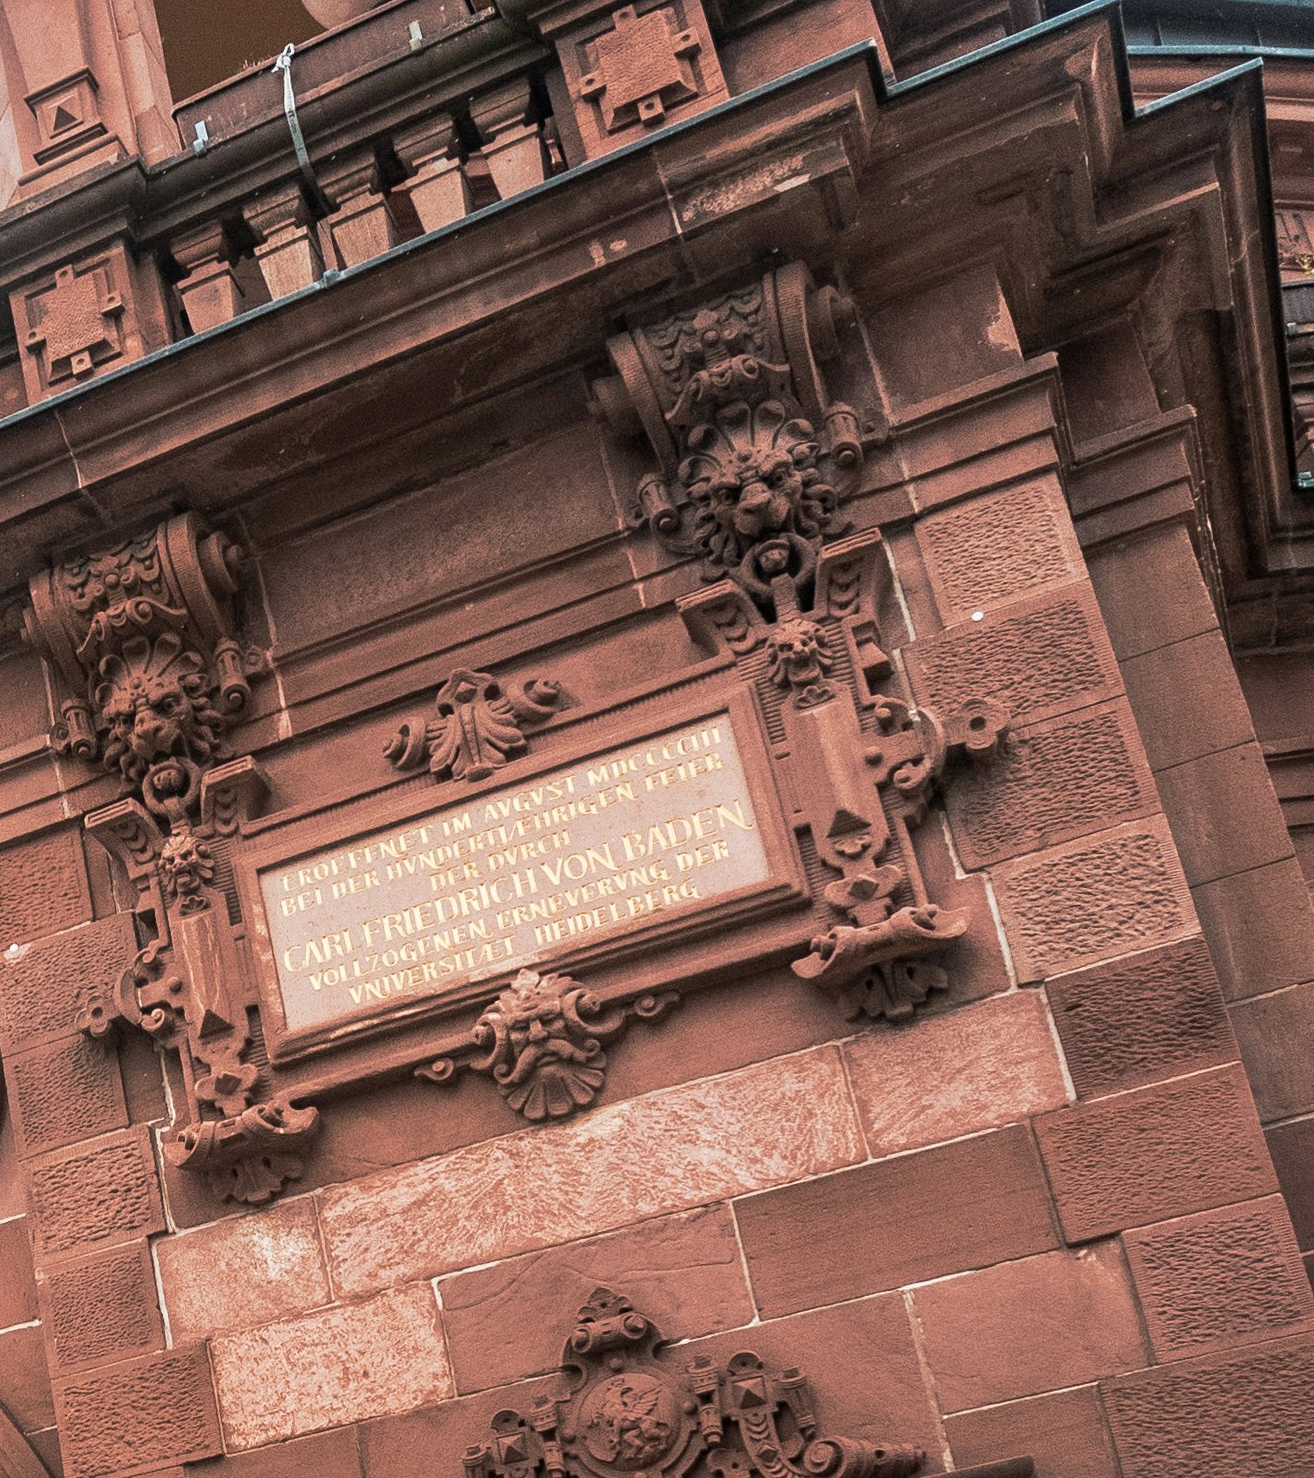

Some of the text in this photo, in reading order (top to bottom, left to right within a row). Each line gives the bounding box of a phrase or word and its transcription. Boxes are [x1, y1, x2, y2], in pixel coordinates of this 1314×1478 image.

[281, 887, 323, 917] BEI
[332, 870, 381, 899] DER
[645, 752, 723, 791] FEIER
[282, 726, 722, 892] EROEFFNET IM AVGVST MDCCCCIII
[284, 798, 754, 971] CARL FRIEDRICH VON BADEN
[429, 829, 571, 891] DER DVRCH
[309, 839, 730, 991] VOLLZOGENEN ERNEVERVNG DER
[534, 877, 700, 946] HEIDELBERG
